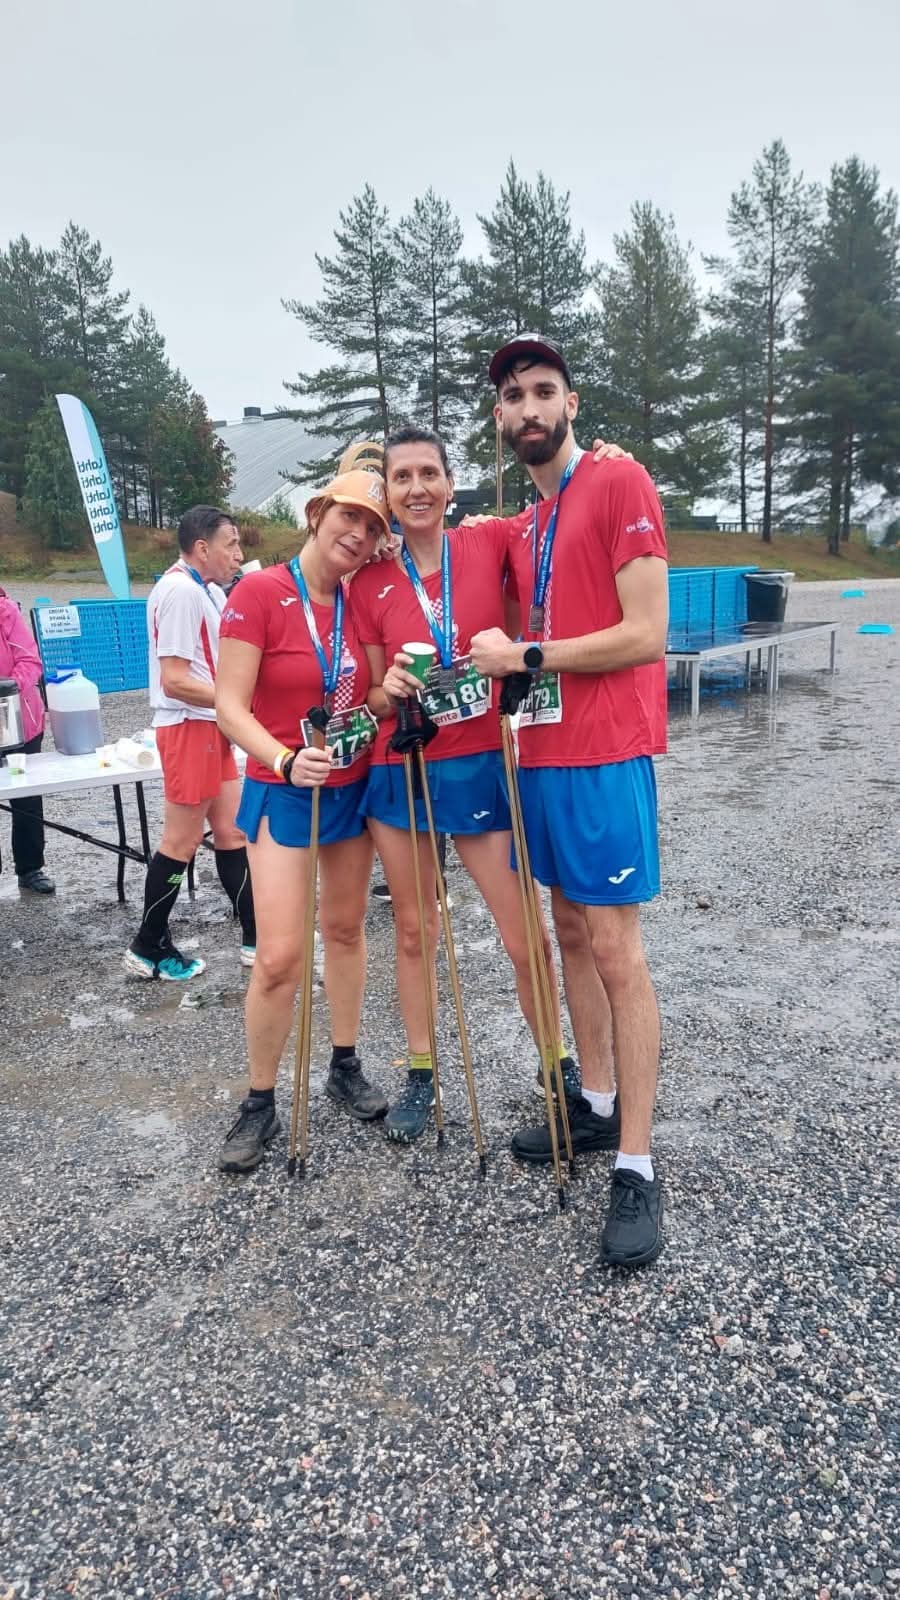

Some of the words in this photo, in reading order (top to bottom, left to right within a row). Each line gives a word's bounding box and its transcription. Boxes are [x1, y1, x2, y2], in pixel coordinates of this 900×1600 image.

[445, 678, 487, 708] 180
[432, 711, 458, 724] enta
[333, 730, 371, 757] 173
